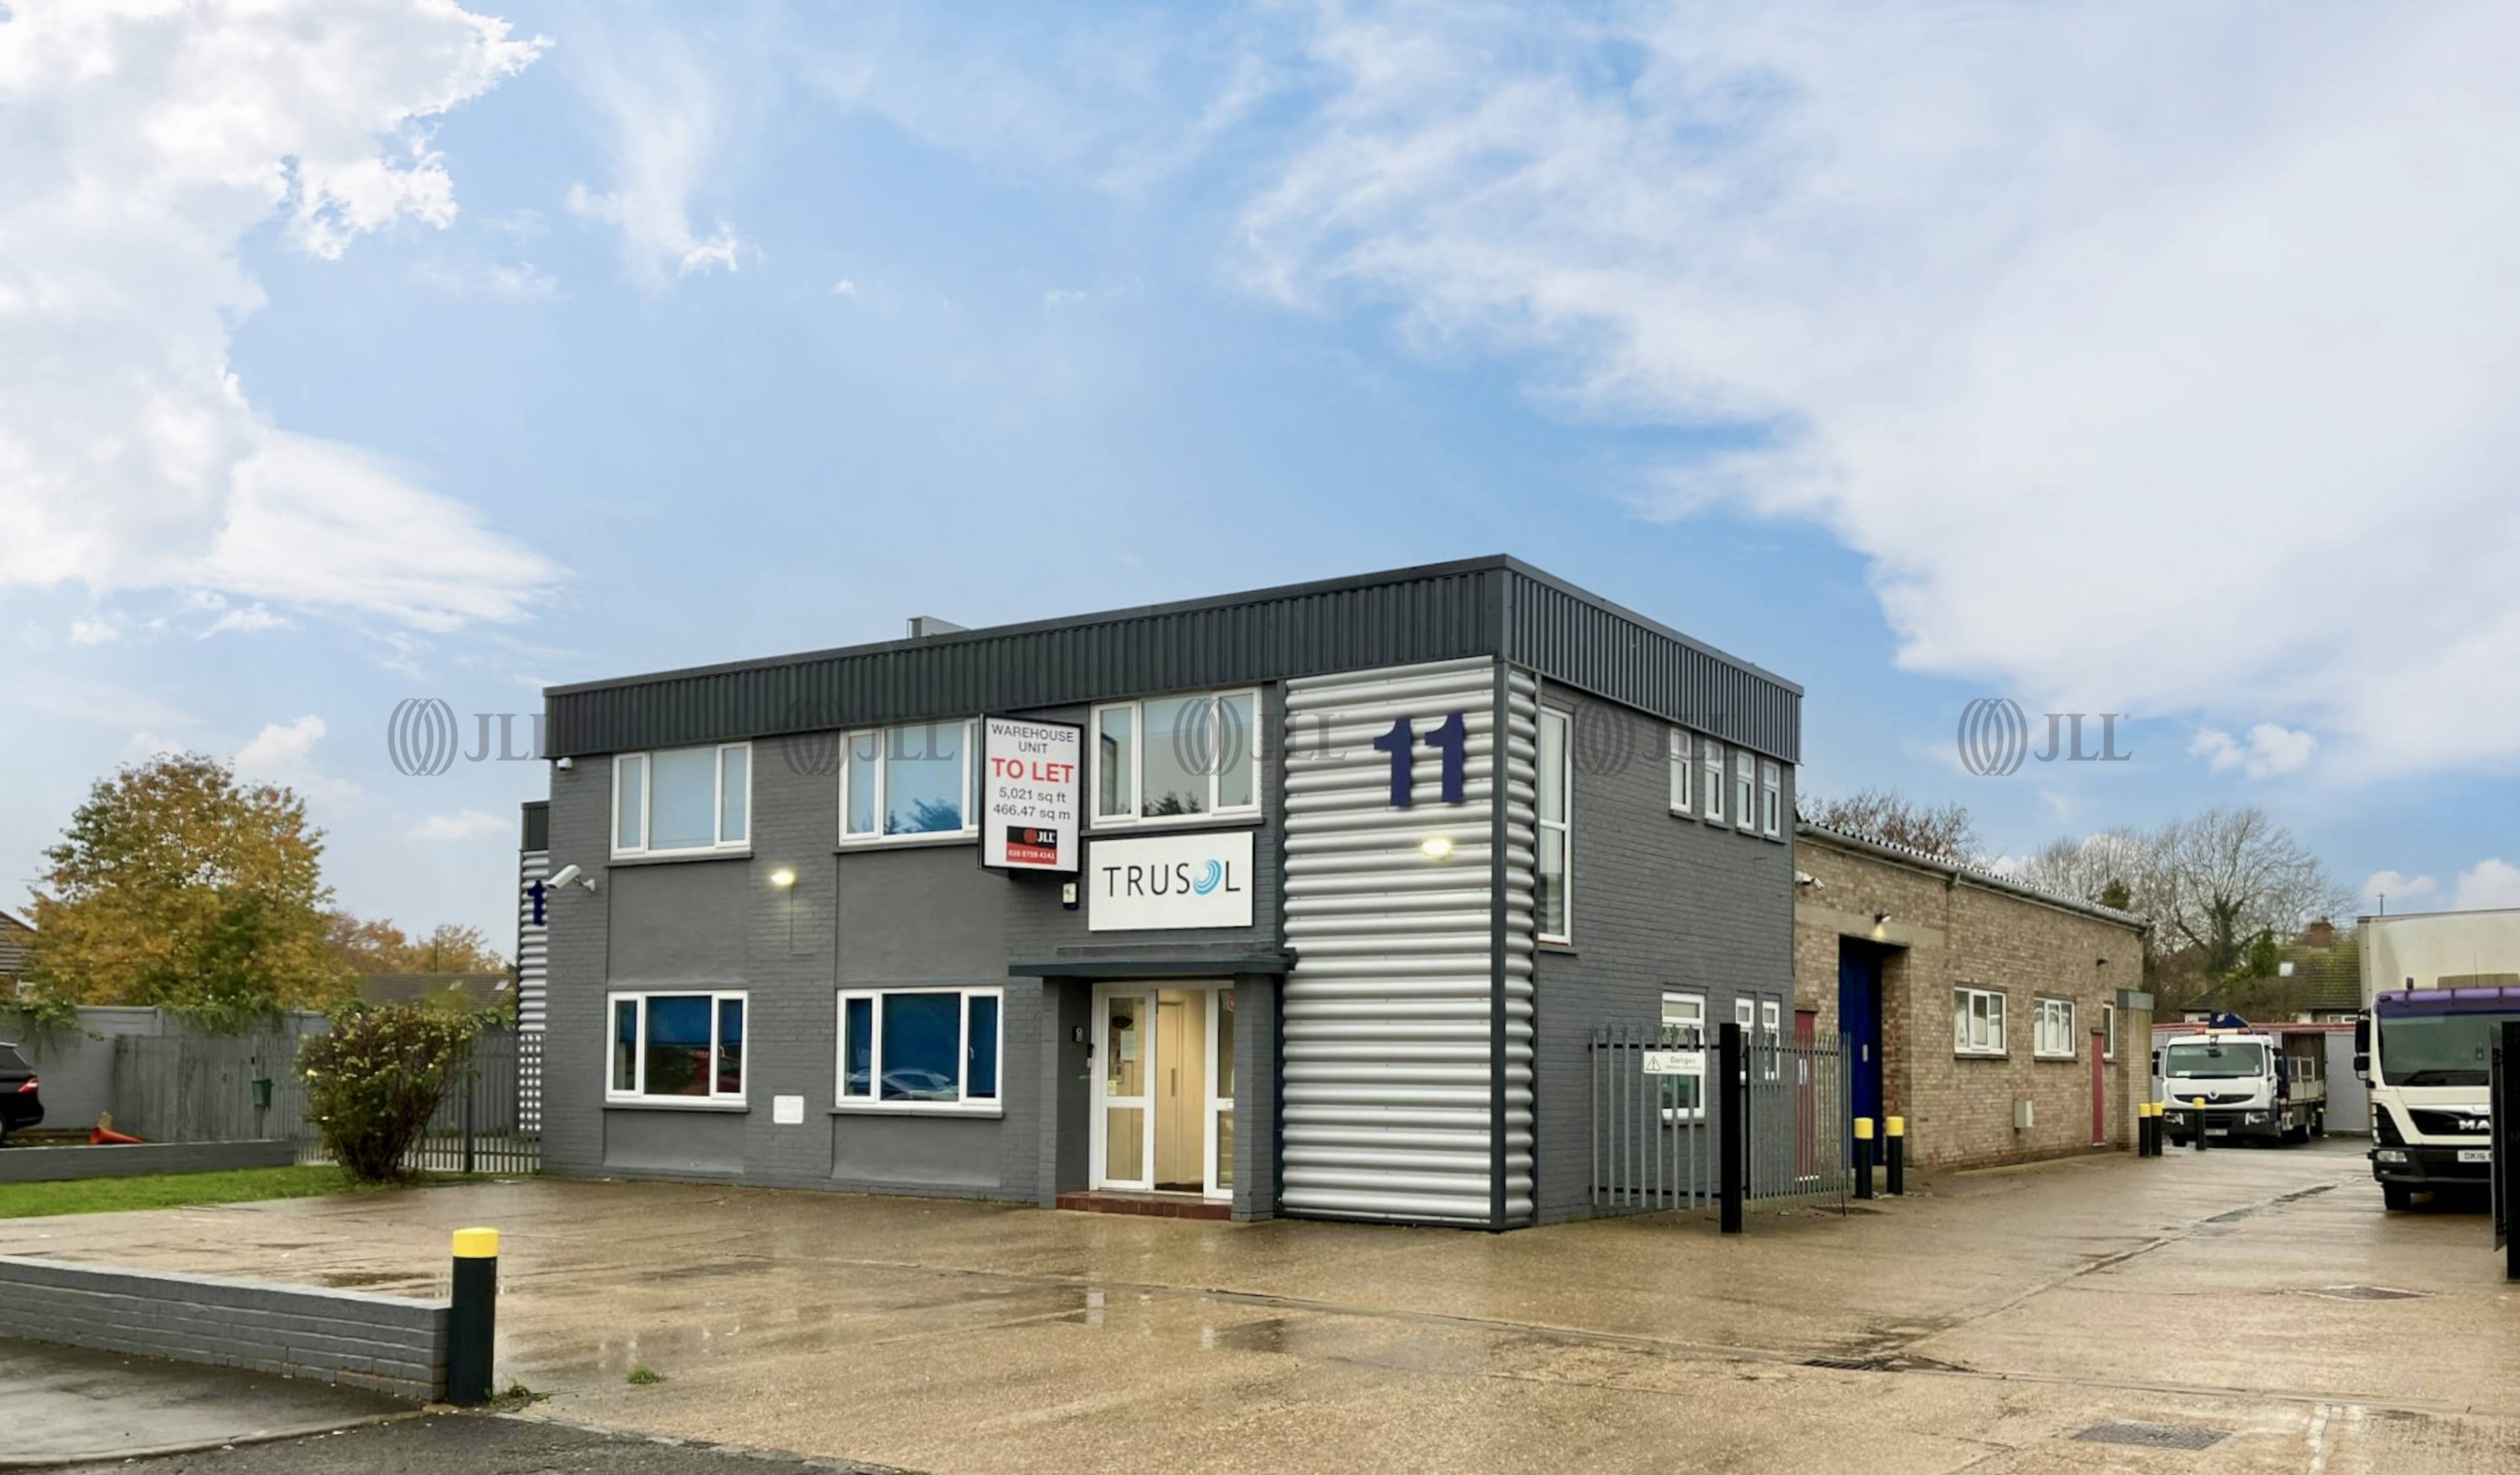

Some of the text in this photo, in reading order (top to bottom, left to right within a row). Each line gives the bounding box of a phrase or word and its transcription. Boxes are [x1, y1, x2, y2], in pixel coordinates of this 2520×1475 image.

[991, 723, 1075, 743] WAREHOUSE
[1018, 741, 1049, 754] UNIT
[1374, 711, 1465, 806] 11
[992, 758, 1075, 784] TO LET
[999, 787, 1066, 805] 5,021 sq ft
[993, 803, 1071, 821] 466.47 sq m
[1037, 831, 1056, 844] JLL
[1102, 859, 1241, 897] TRUSOL
[1670, 1056, 1696, 1065] Danger
[2458, 1119, 2491, 1130] MA
